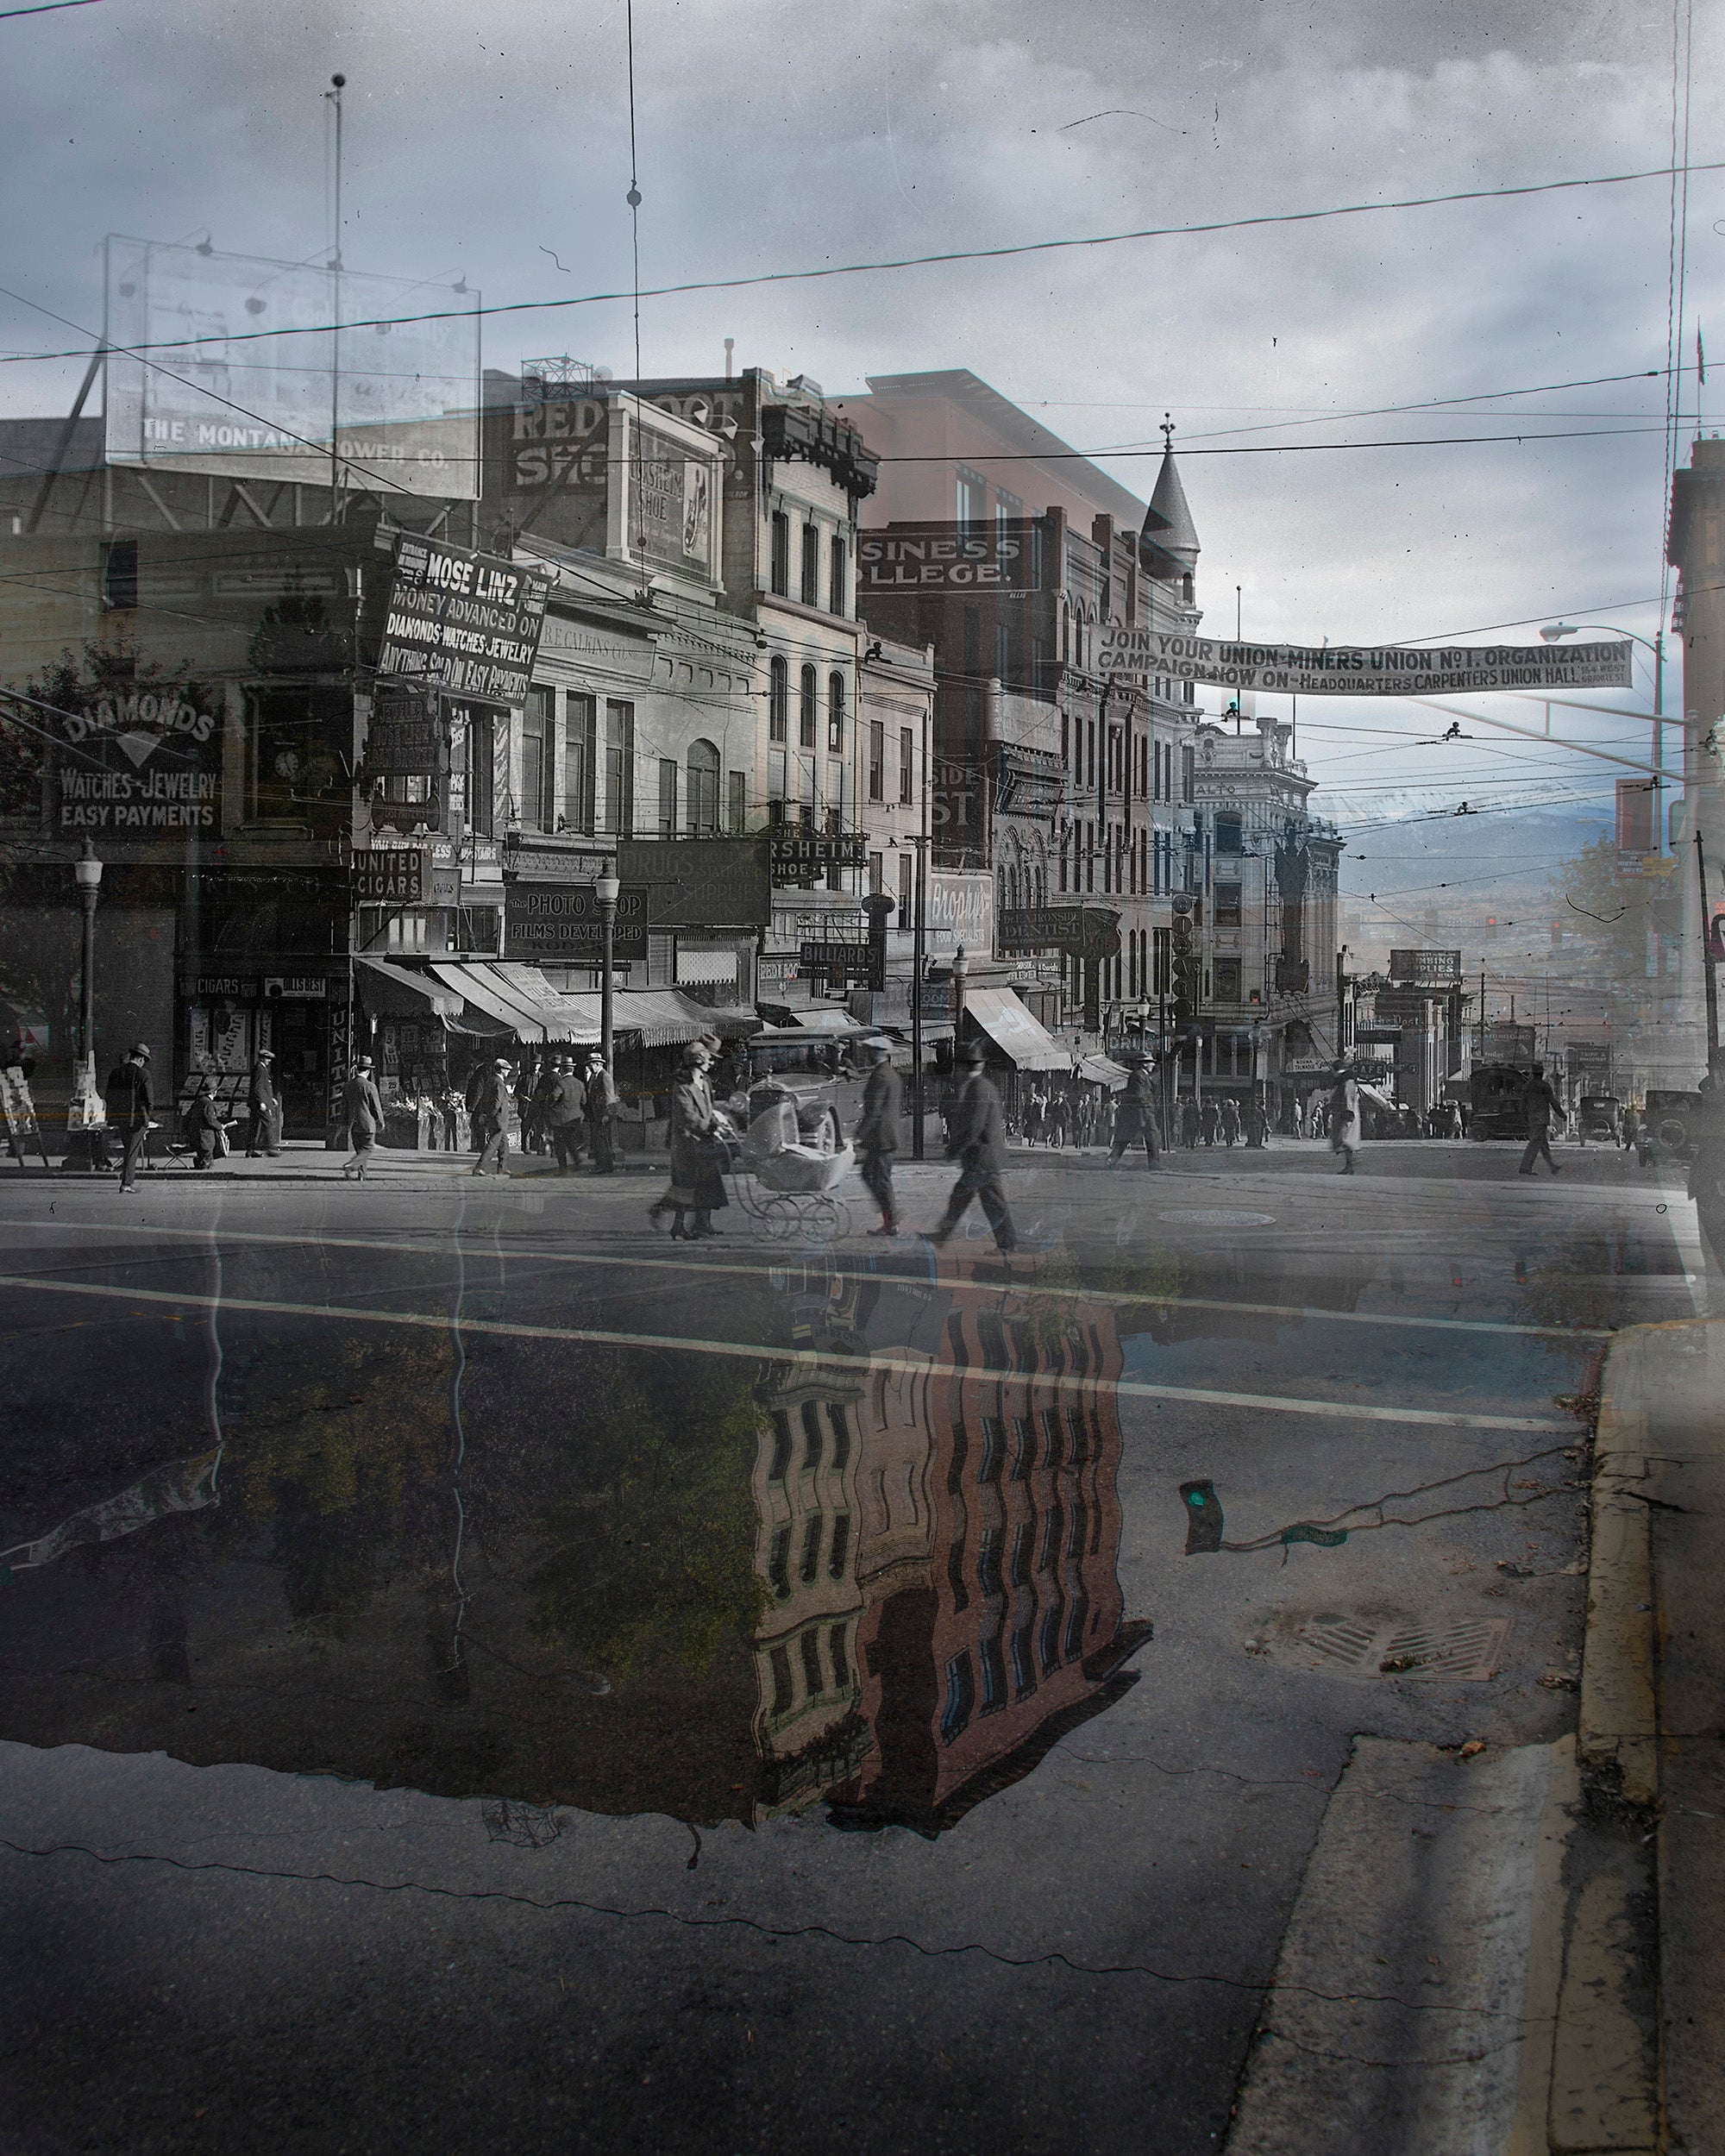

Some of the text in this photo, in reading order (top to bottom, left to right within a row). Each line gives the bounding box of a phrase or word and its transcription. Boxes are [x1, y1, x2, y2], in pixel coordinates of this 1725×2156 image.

[511, 399, 604, 440] RED
[145, 418, 450, 470] THE MONTANA POWER CO.
[861, 539, 1019, 561] SINESS
[426, 553, 474, 594] MOSE
[475, 567, 518, 606] LINZ
[392, 583, 447, 616] MONEY
[446, 598, 518, 633] ADVANCED
[519, 616, 539, 638] ON
[486, 637, 534, 665] JEWELRY
[1101, 630, 1151, 651] JOIN
[1157, 635, 1213, 661] YOUR
[1370, 651, 1432, 671] UNION
[1484, 646, 1626, 666] ORGANIZATION
[380, 642, 529, 700] ANYTHING SOLD ON EASY PAYMENTS
[1097, 651, 1206, 679] CAMPAIGN
[1212, 666, 1257, 687] NOW
[1414, 668, 1497, 691] CARPENTERS
[1501, 667, 1540, 685] UNION
[1544, 666, 1579, 684] HALL
[1582, 674, 1611, 683] GRANITE
[62, 694, 215, 743] DIAMONDS
[60, 768, 216, 799] WATCHES JEWELRY
[60, 805, 213, 826] EASY PAYMENTS
[358, 852, 419, 872] UNITED
[358, 875, 419, 895] CIGARS
[527, 893, 586, 916] PHOTO
[593, 894, 642, 917] SOP
[511, 923, 643, 941] FILMS DEVELPED
[937, 929, 985, 943] FOOD SPECIALISTS
[1005, 923, 1081, 937] DENTIST
[804, 945, 876, 963] BILLIARDS
[304, 978, 323, 992] BEST
[837, 970, 875, 979] SHINING
[198, 978, 239, 993] CIGARS
[920, 993, 958, 1005] OOMS
[1352, 1065, 1383, 1074] CAFE
